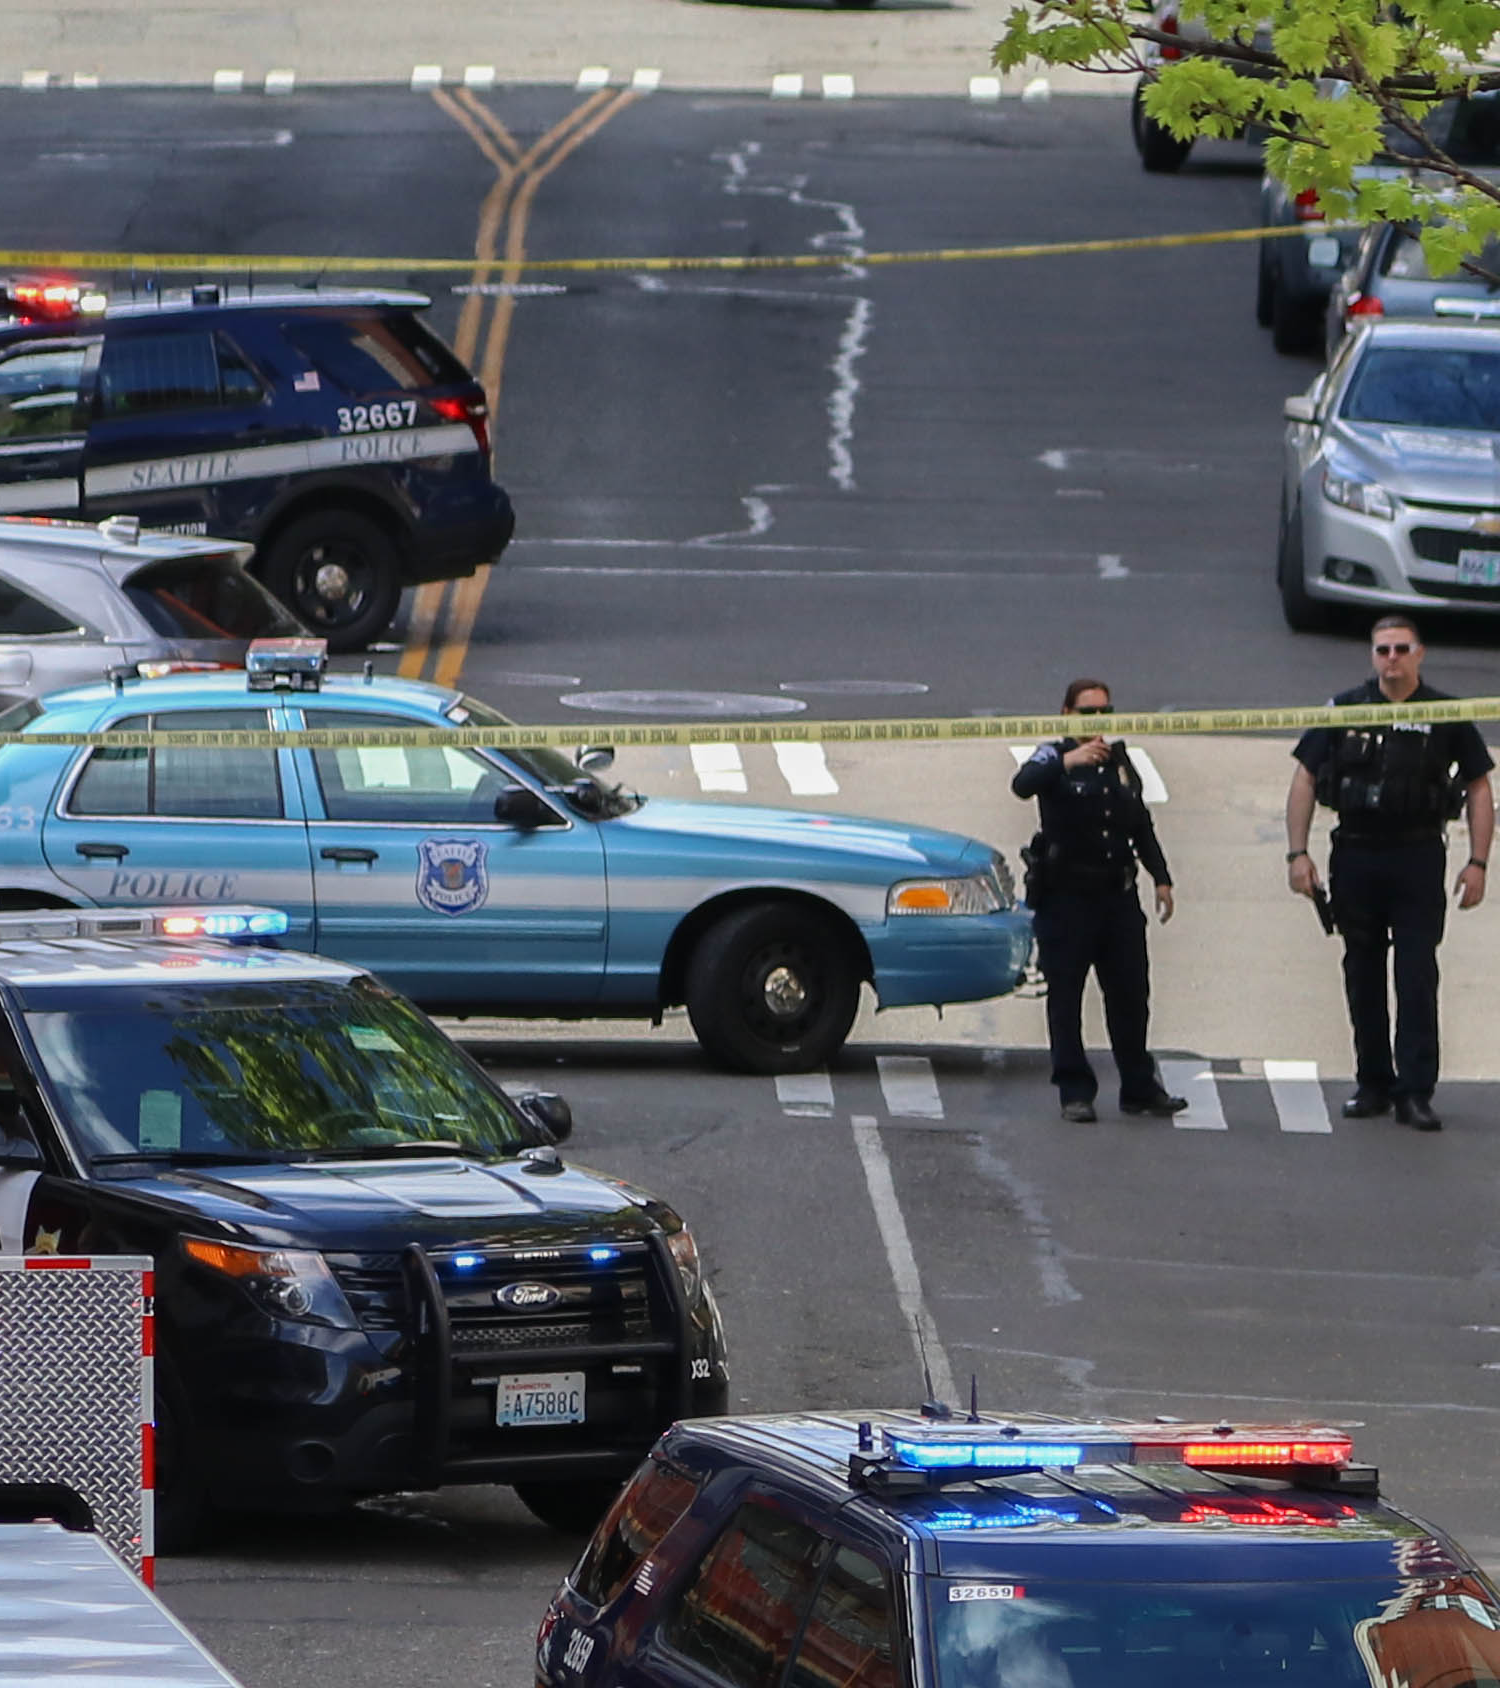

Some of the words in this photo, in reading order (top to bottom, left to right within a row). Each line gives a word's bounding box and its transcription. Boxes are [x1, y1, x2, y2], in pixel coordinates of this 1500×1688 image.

[337, 402, 417, 433] 32667
[341, 434, 424, 462] POLICE
[130, 456, 241, 488] SEATTLE
[160, 522, 207, 537] ICATION
[109, 873, 238, 898] POLICE
[514, 1391, 580, 1418] A7588C
[950, 1586, 1013, 1600] 32659
